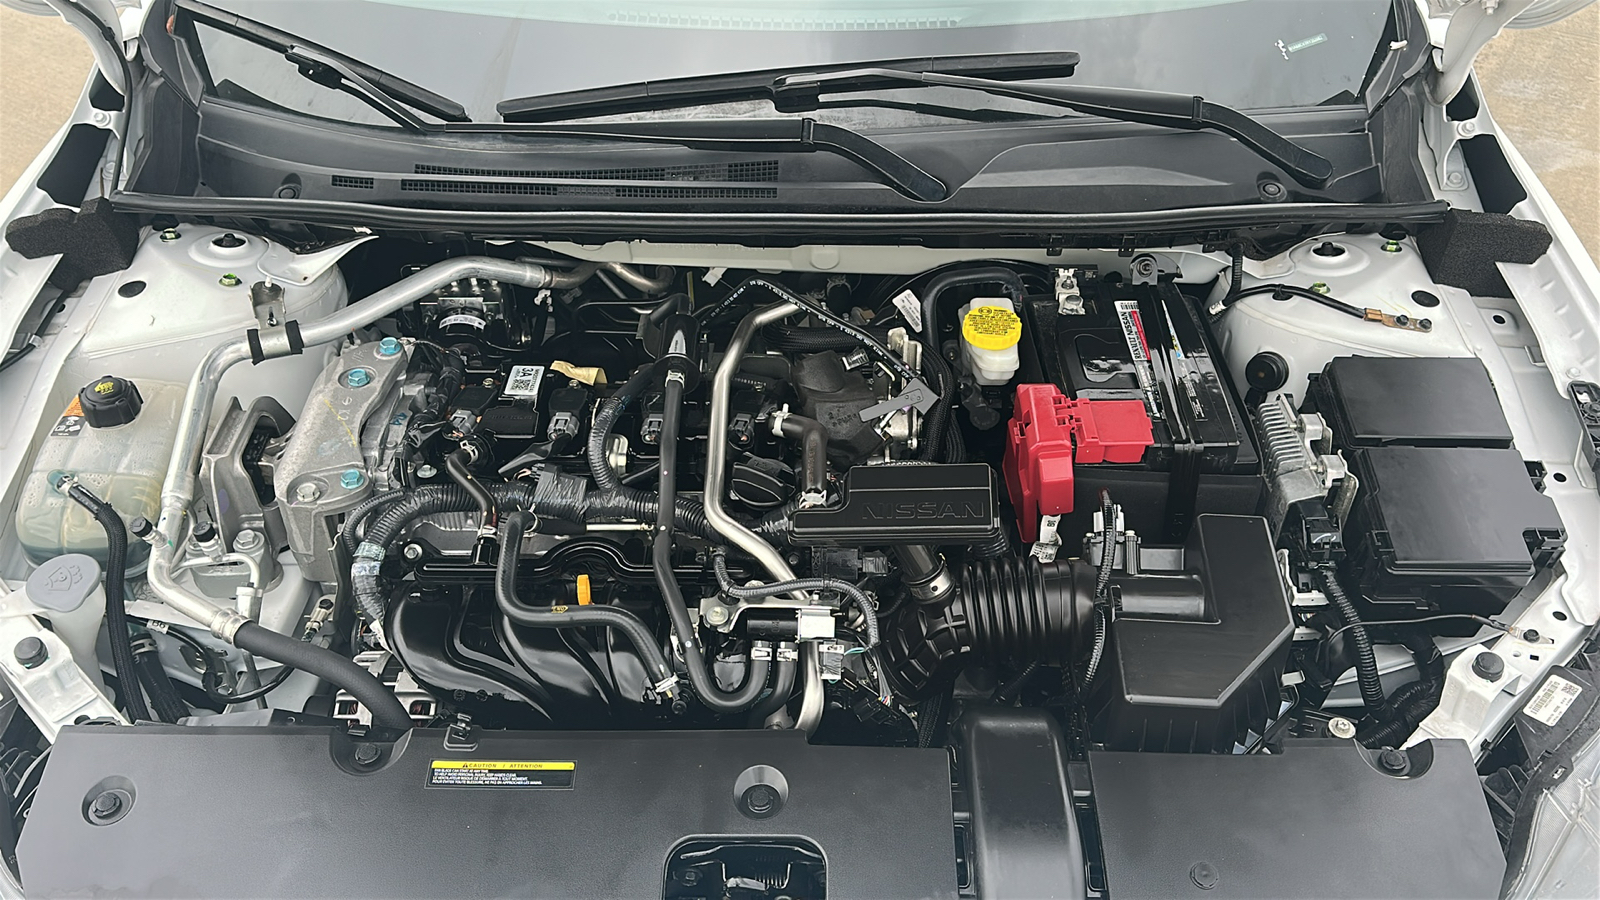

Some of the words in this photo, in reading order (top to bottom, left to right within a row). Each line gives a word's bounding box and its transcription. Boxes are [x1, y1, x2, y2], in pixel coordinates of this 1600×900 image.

[1120, 310, 1134, 336] NISSAN
[520, 367, 534, 378] 3A
[862, 501, 985, 520] NISSAN
